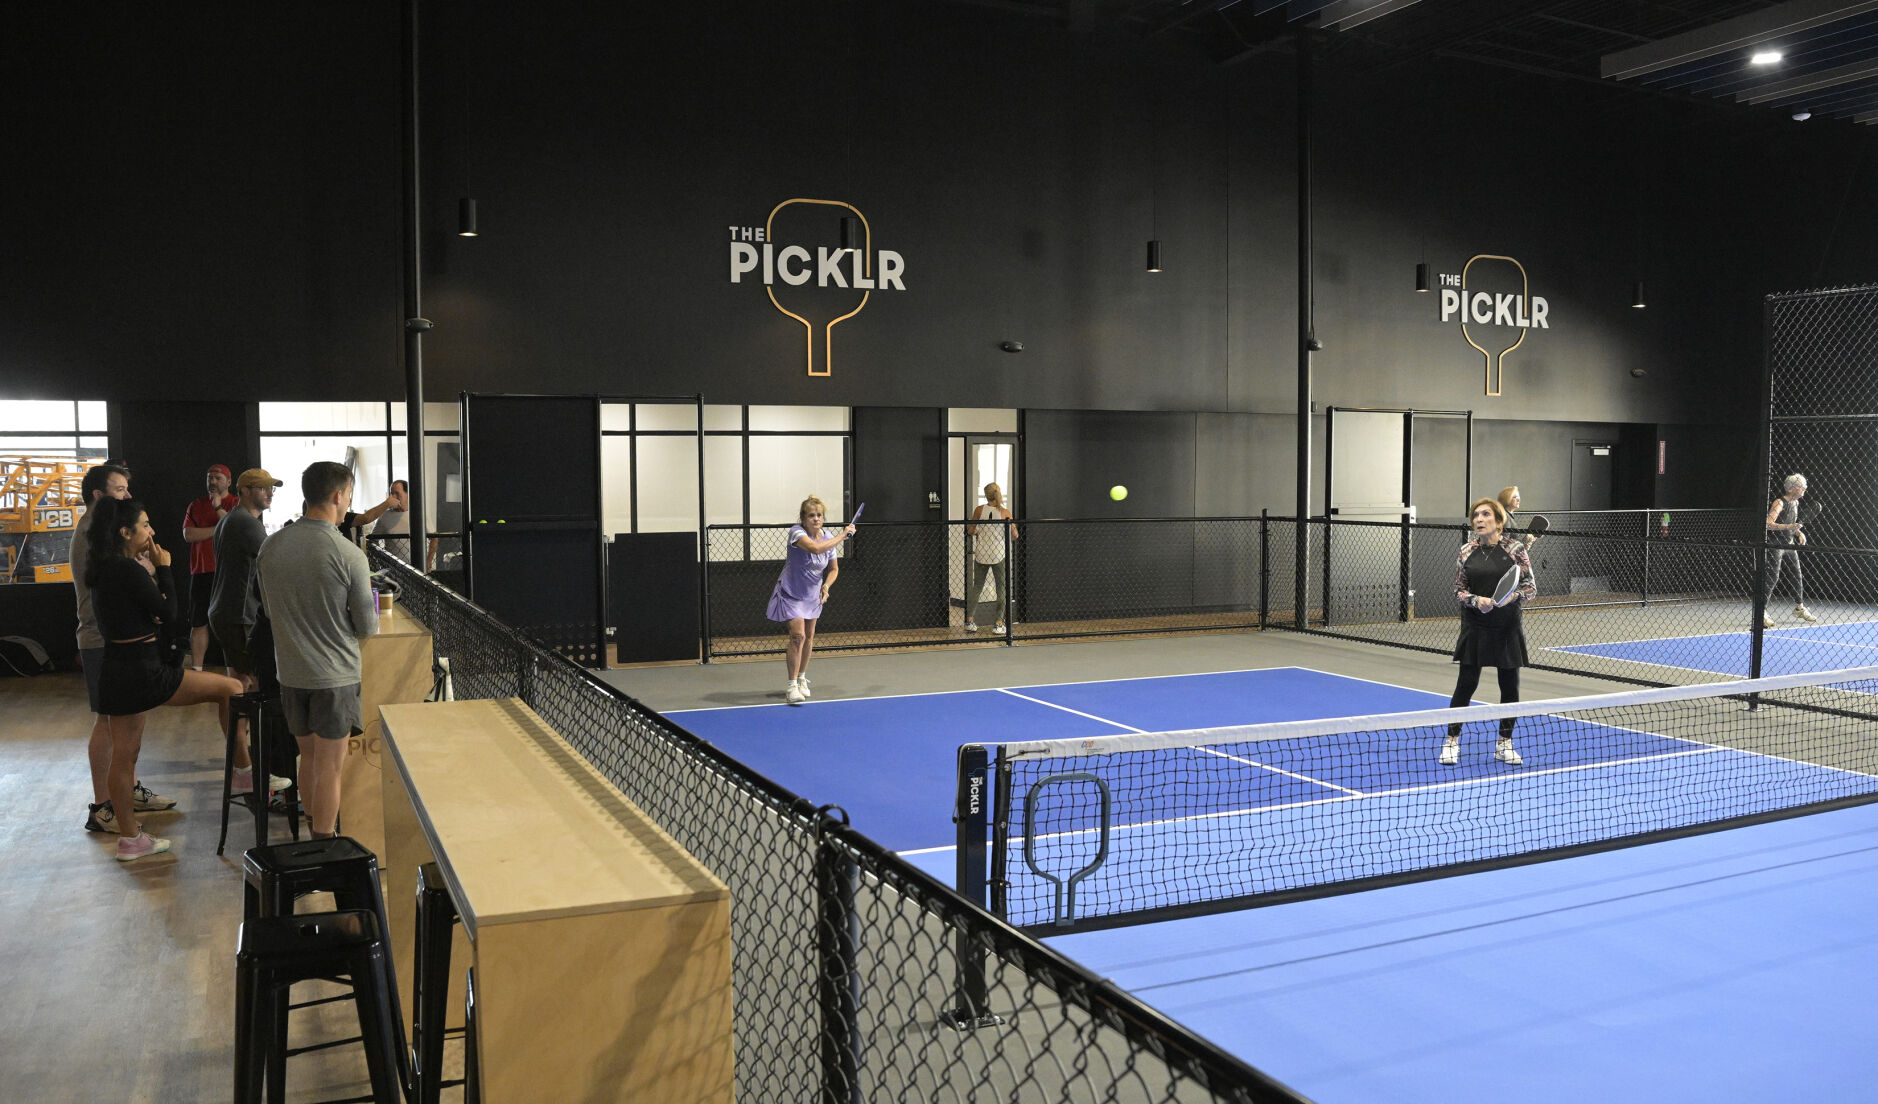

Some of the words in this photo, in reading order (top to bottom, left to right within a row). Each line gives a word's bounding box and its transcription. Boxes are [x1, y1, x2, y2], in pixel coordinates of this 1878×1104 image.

[729, 226, 765, 242] THE
[730, 242, 907, 290] PICKLR
[1439, 273, 1461, 286] THE
[1441, 289, 1549, 329] PICKLR
[970, 777, 979, 814] PICKLR
